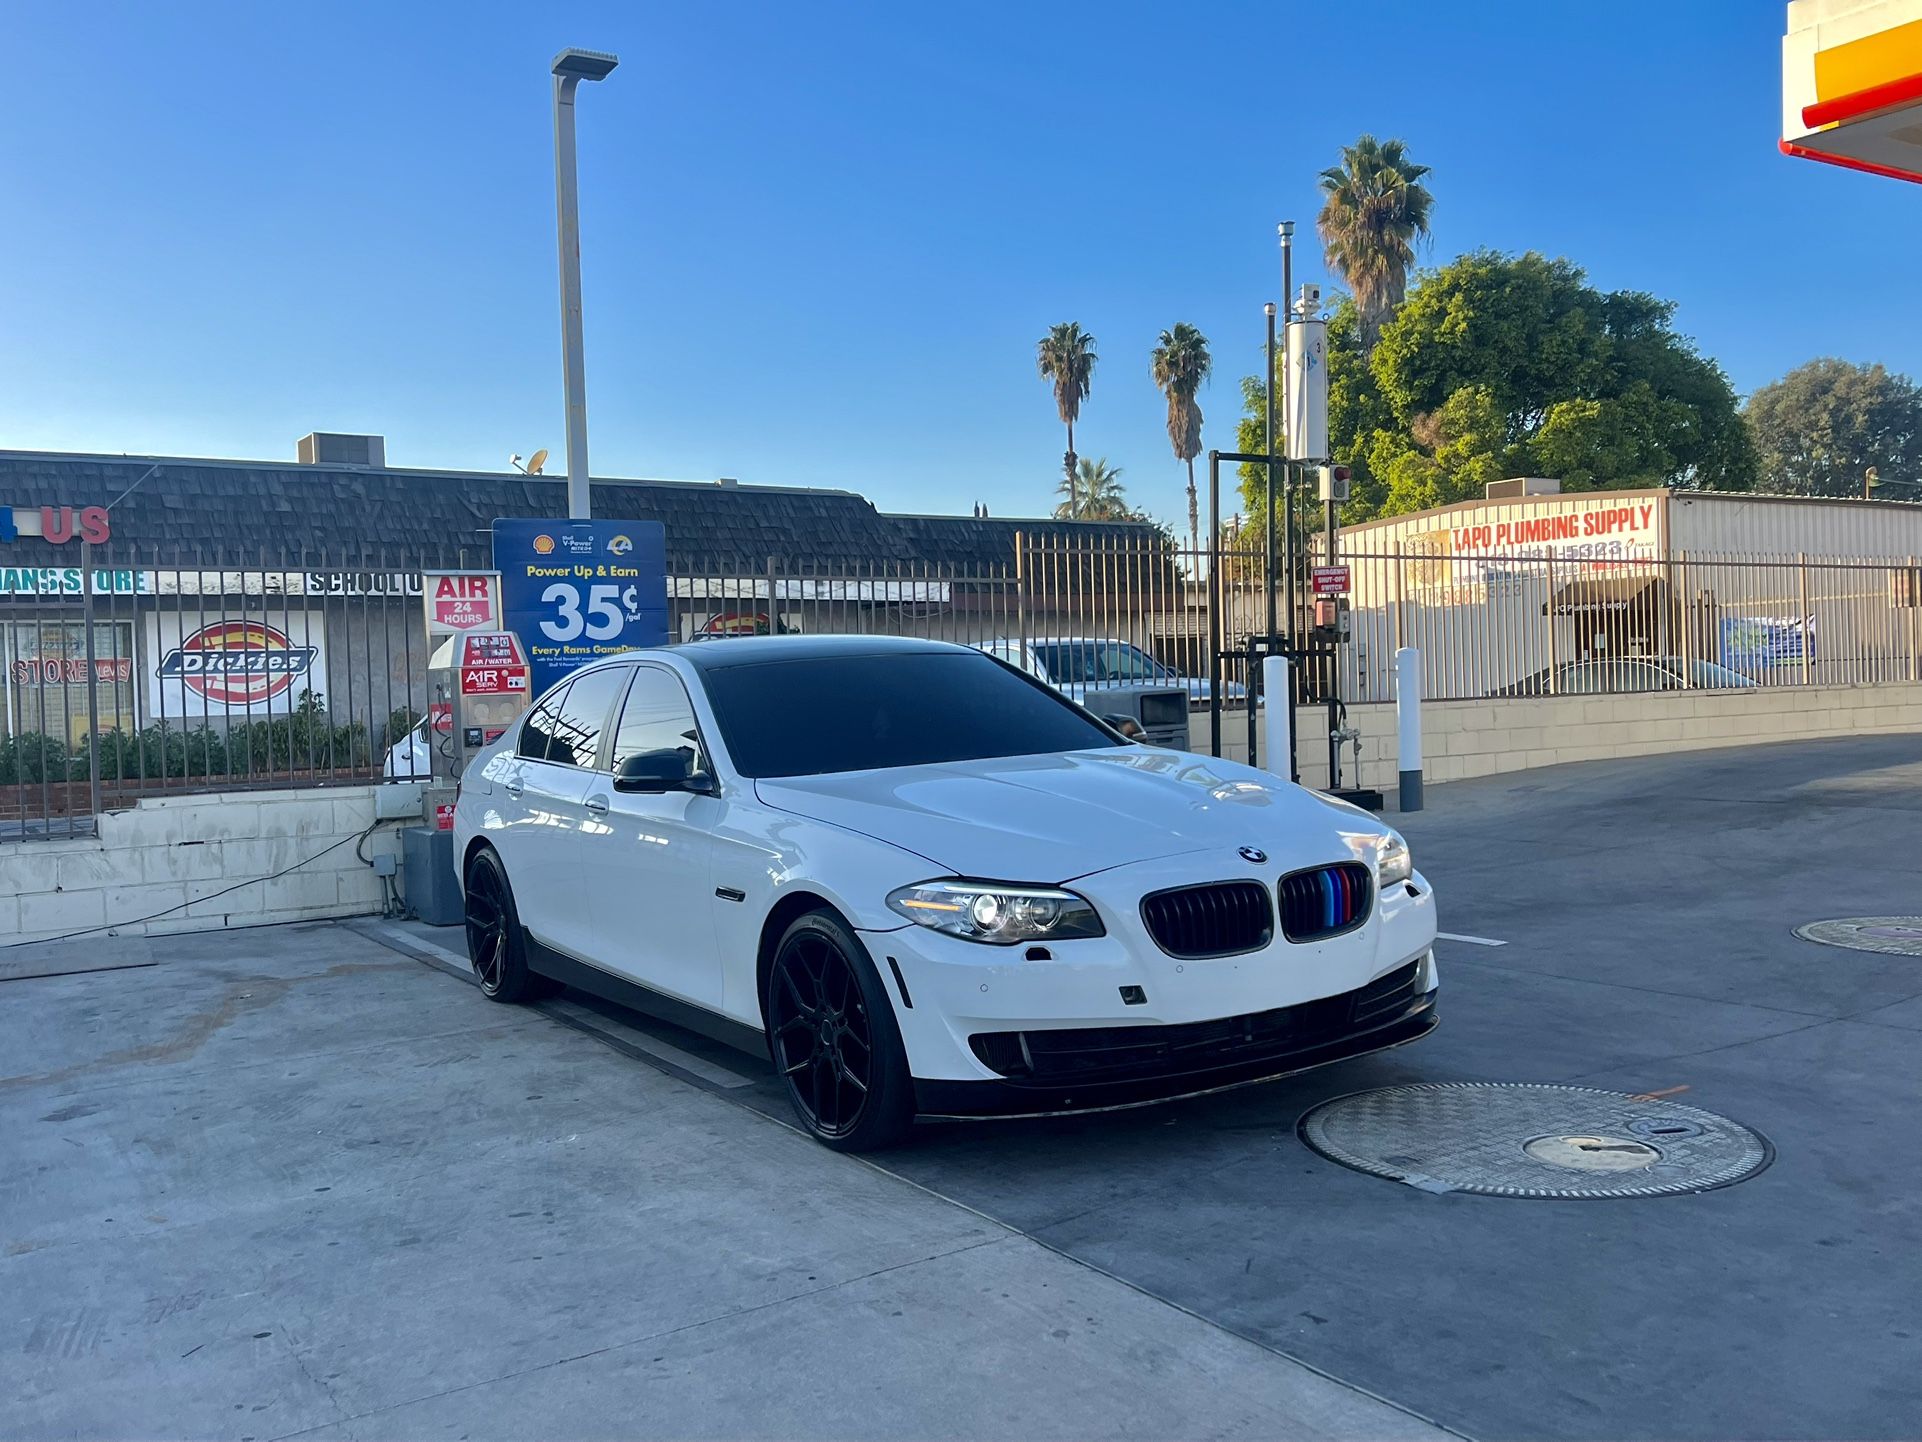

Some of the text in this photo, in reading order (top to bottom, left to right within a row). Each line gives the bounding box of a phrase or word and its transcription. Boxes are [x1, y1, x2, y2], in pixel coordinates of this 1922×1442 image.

[40, 506, 111, 544] US
[1453, 504, 1653, 551] TAPO PLUMBING SUPPLY
[527, 565, 638, 579] Power Up & Earn
[1314, 567, 1348, 576] EMERGENCY
[0, 569, 146, 591] ANS SORE
[311, 573, 400, 592] SCHOOL
[435, 577, 488, 598] AIR
[1317, 576, 1346, 584] SHUT-OFF
[454, 602, 472, 613] 24
[444, 614, 483, 624] HOURS
[532, 645, 560, 656] Every
[563, 645, 590, 654] Rams
[175, 651, 301, 671] Dickies
[11, 658, 89, 685] STORE
[465, 670, 498, 683] AIR
